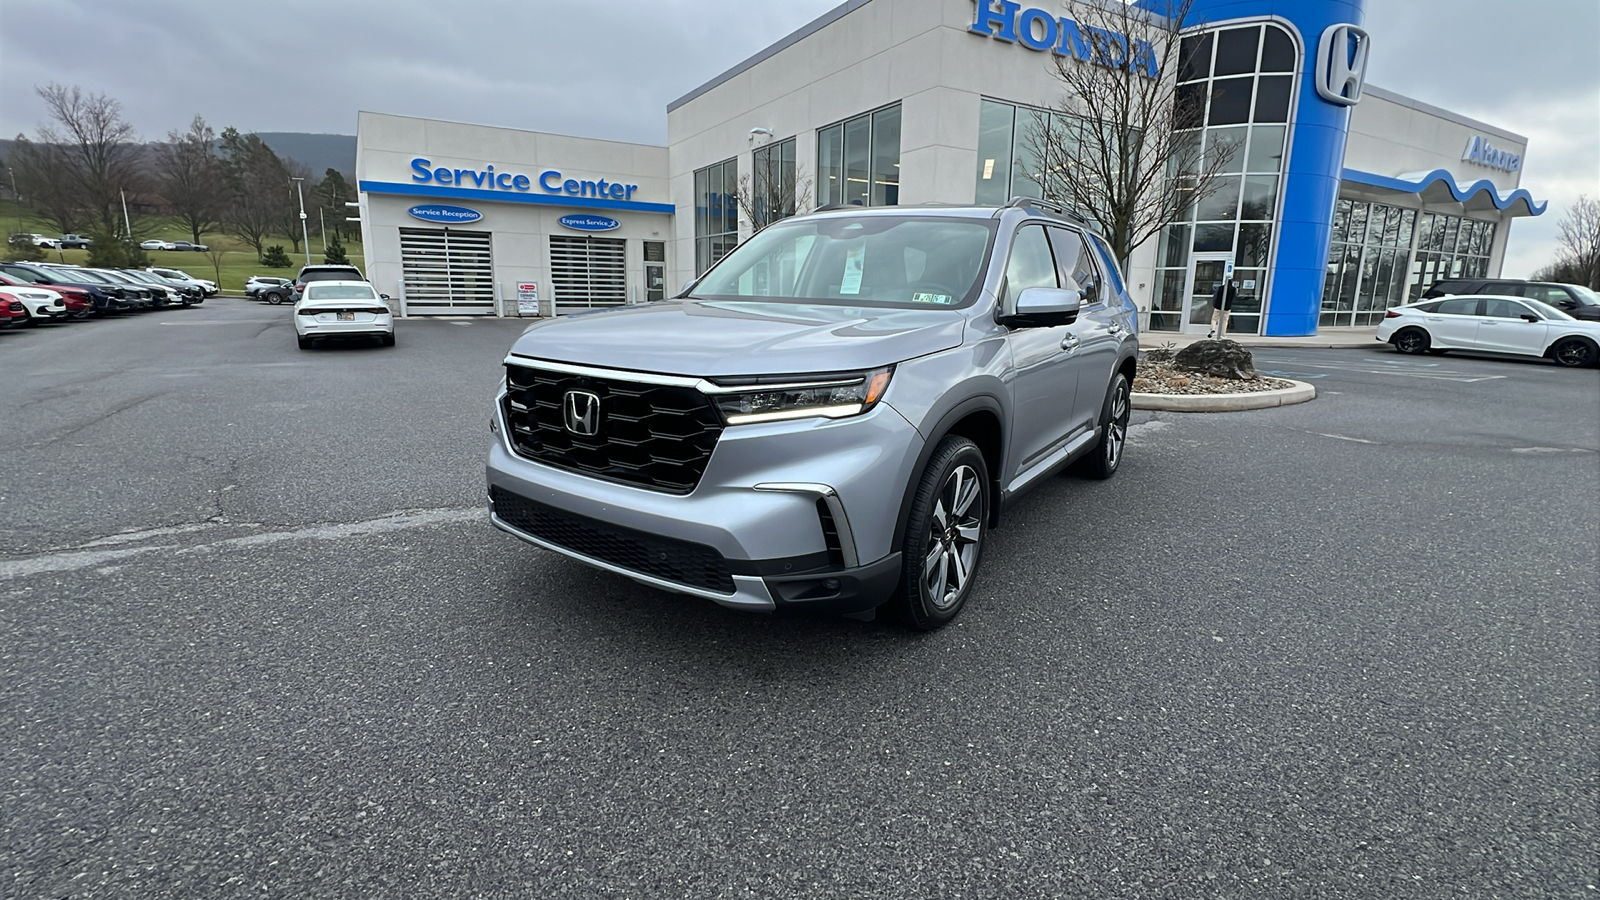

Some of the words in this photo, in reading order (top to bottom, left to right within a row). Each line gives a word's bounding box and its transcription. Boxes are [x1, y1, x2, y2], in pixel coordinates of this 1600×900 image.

[967, 0, 1158, 78] HONDA
[411, 158, 530, 191] Service
[539, 170, 638, 199] Center
[412, 207, 441, 216] Service
[442, 209, 478, 219] Reception
[561, 217, 585, 226] Express
[586, 219, 608, 227] Service
